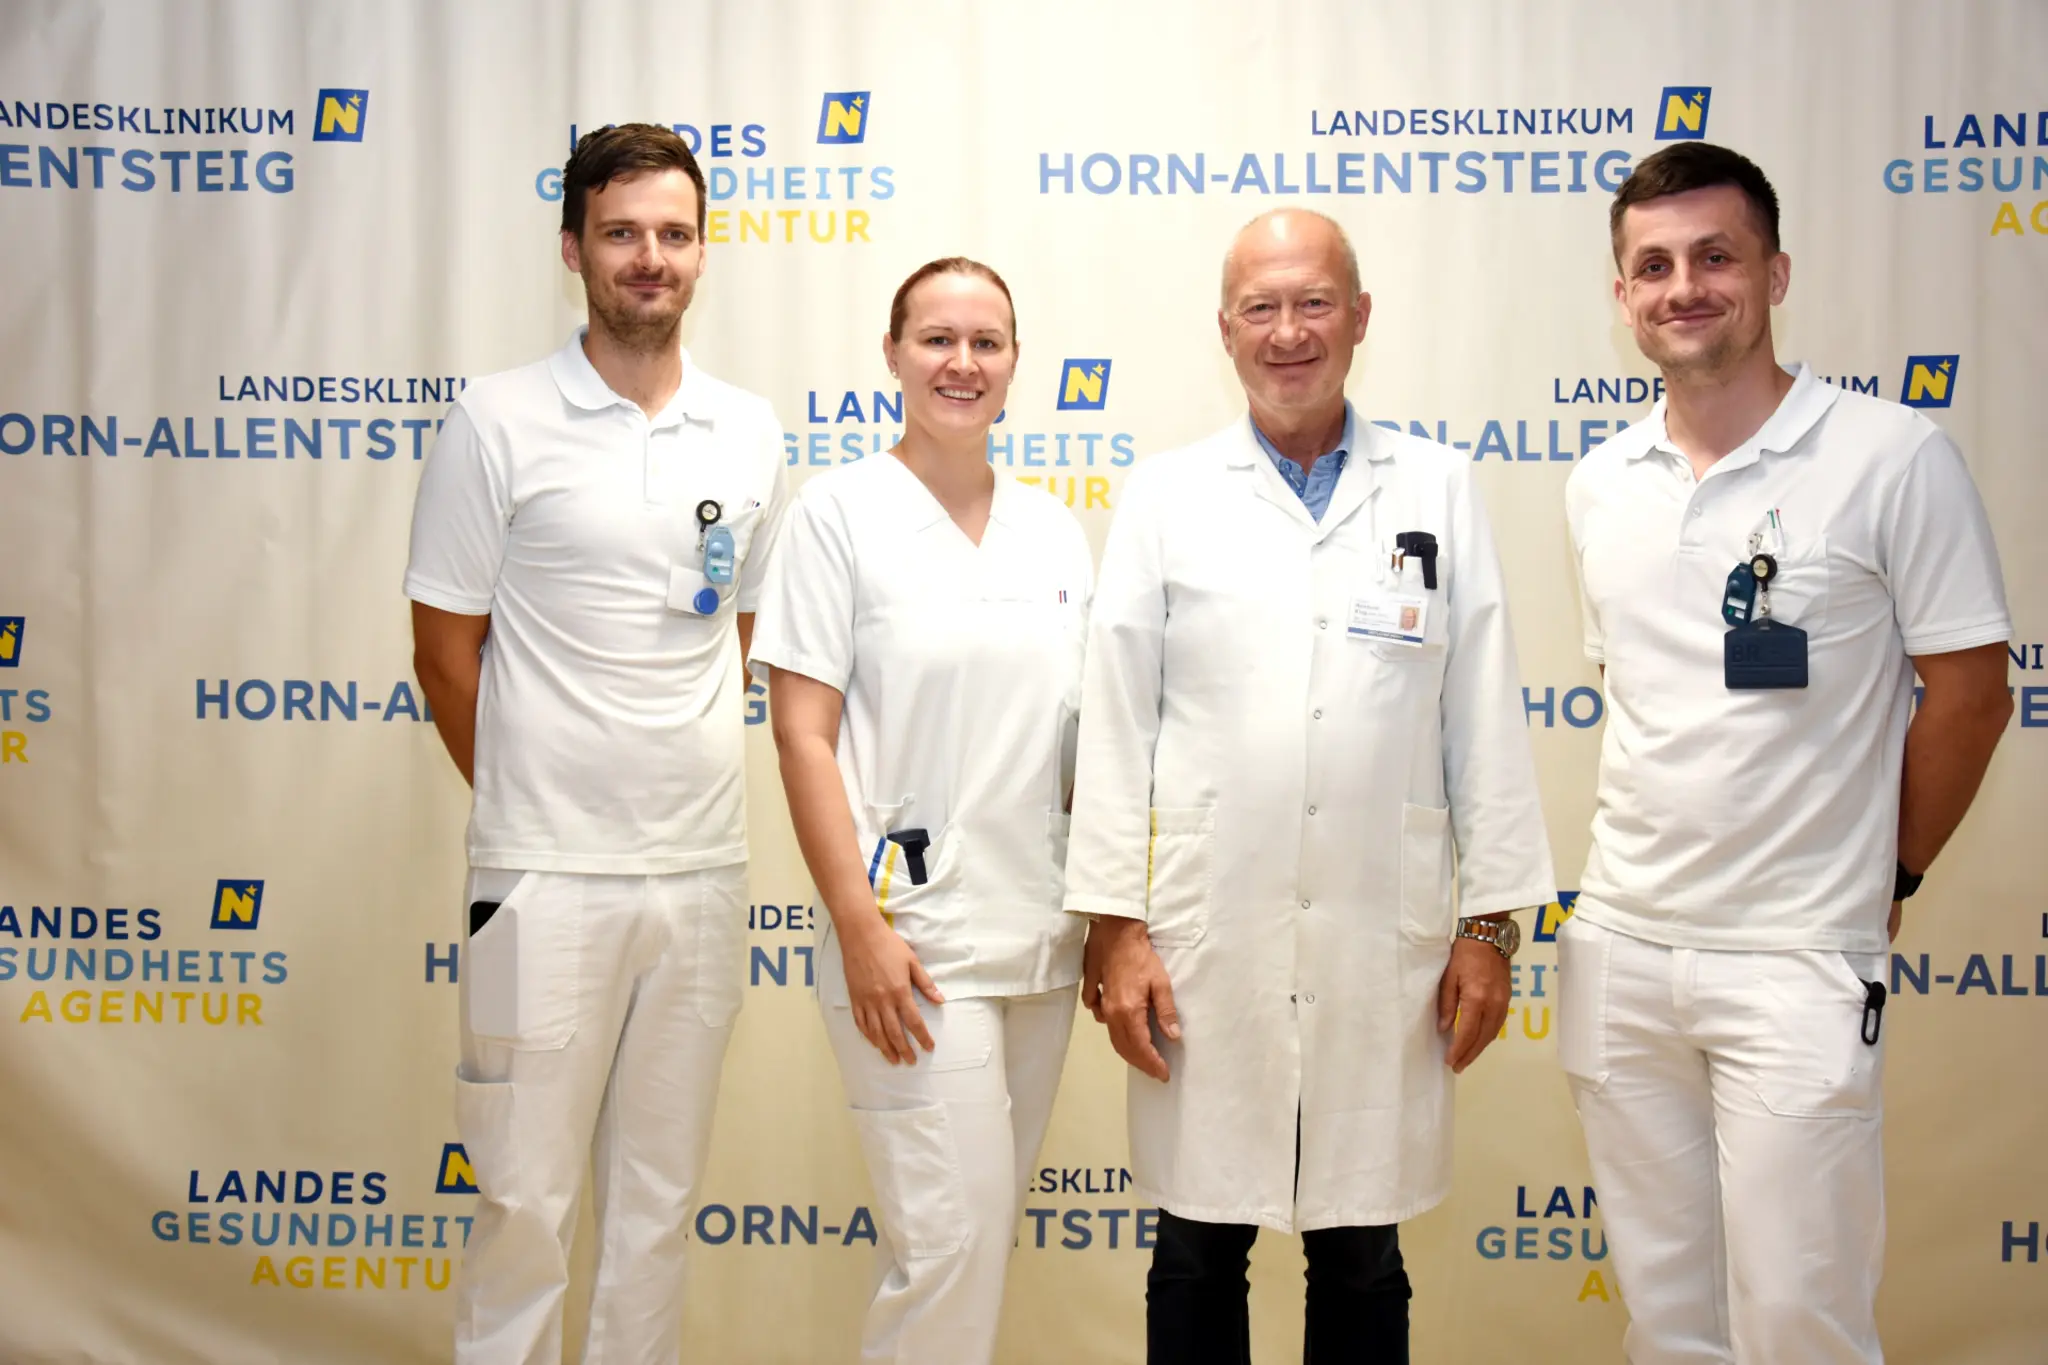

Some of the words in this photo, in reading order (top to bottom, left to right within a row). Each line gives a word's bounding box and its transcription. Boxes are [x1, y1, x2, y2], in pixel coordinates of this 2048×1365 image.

[1311, 108, 1633, 135] LANDESKLINIKUM
[0, 143, 294, 193] ENTSTEIG
[1039, 150, 1632, 195] HORN-ALLENTSTEIG
[219, 375, 466, 403] LANDESKLINI
[0, 412, 444, 461] ORN-ALLENTST
[196, 679, 434, 722] HORN-A
[0, 906, 162, 940] ANDES
[0, 947, 288, 984] SUNDHEITS
[19, 990, 264, 1025] AGENTUR
[188, 1170, 387, 1205] LANDES
[1029, 1168, 1132, 1193] SKLIN
[1014, 1208, 1160, 1250] TSTE
[1476, 1226, 1608, 1261] GESU
[2002, 1221, 2048, 1263] H
